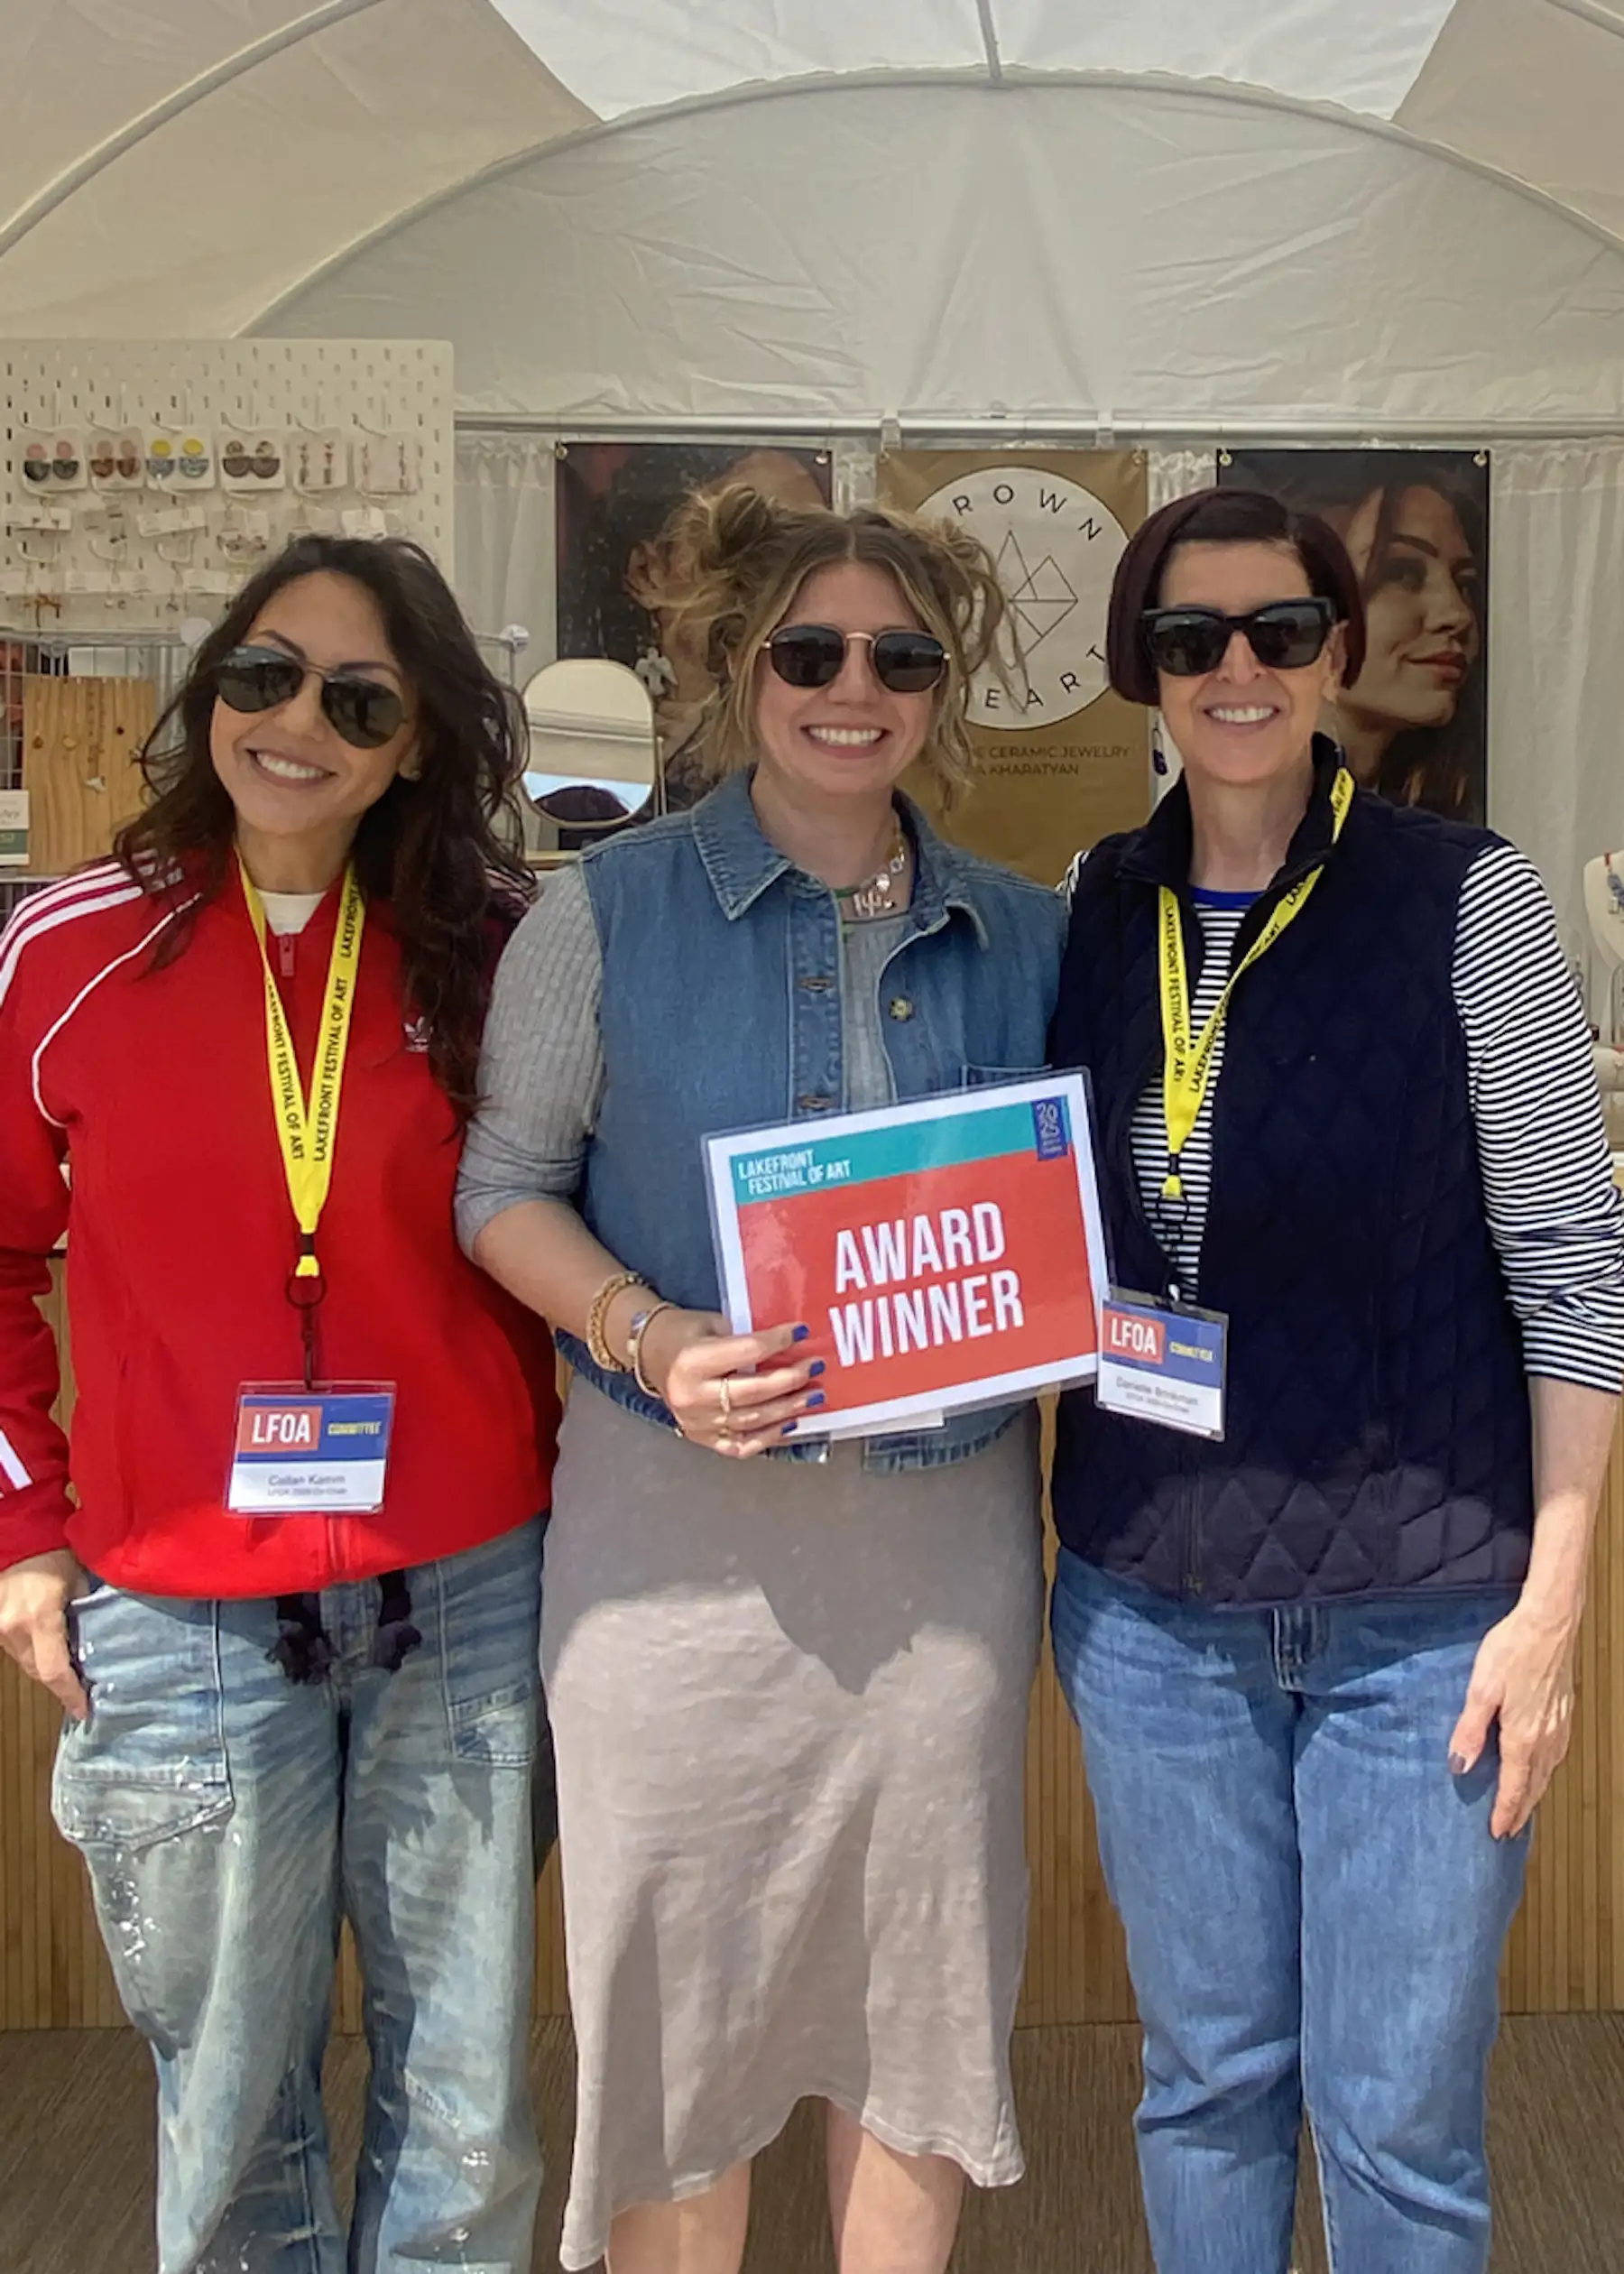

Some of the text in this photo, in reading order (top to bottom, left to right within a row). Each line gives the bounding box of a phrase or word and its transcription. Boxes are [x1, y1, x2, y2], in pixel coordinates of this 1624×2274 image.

[952, 484, 1103, 541] ROWN
[984, 643, 1105, 709] EART
[989, 745, 1058, 759] CERAMIC
[1061, 745, 1130, 759] JEWELRY
[1174, 1037, 1186, 1056] OF
[313, 976, 348, 1162] LAKEFRONT FESTIVAL OF ART
[286, 1112, 300, 1131] OF
[290, 1134, 305, 1160] ART
[738, 1148, 814, 1181] LAKEFRONT
[748, 1159, 851, 1196] FESTIVAL OF ART
[835, 1201, 1005, 1294] AWARD
[828, 1271, 1025, 1368] WINNER
[1111, 1317, 1158, 1356] LFOA
[252, 1413, 311, 1445] LFOA
